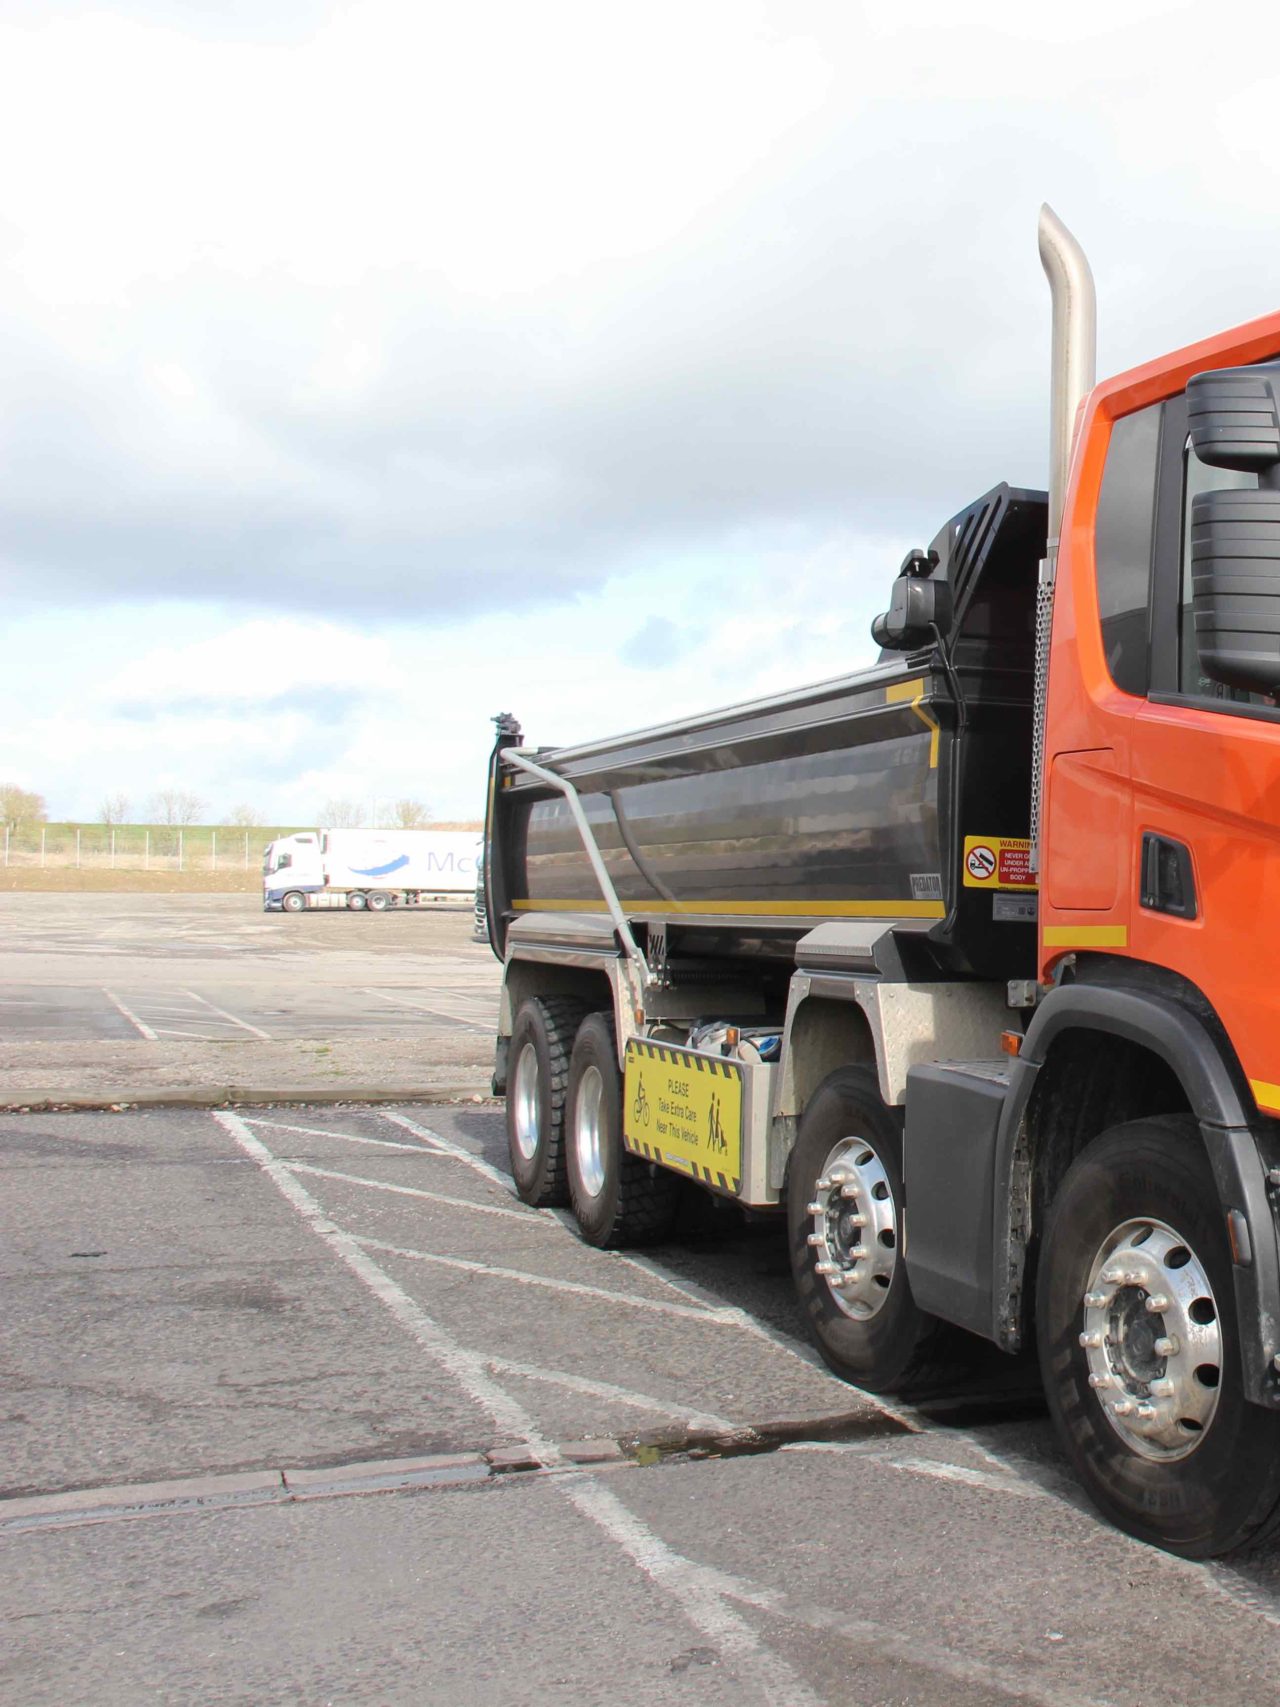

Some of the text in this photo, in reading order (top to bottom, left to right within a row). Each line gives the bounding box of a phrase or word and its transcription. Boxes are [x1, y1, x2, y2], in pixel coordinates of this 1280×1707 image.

[428, 852, 482, 873] Mc
[667, 1079, 689, 1098] PLEASE
[659, 1097, 697, 1122] Take Extra Care
[656, 1118, 699, 1146] Near This Vehicle
